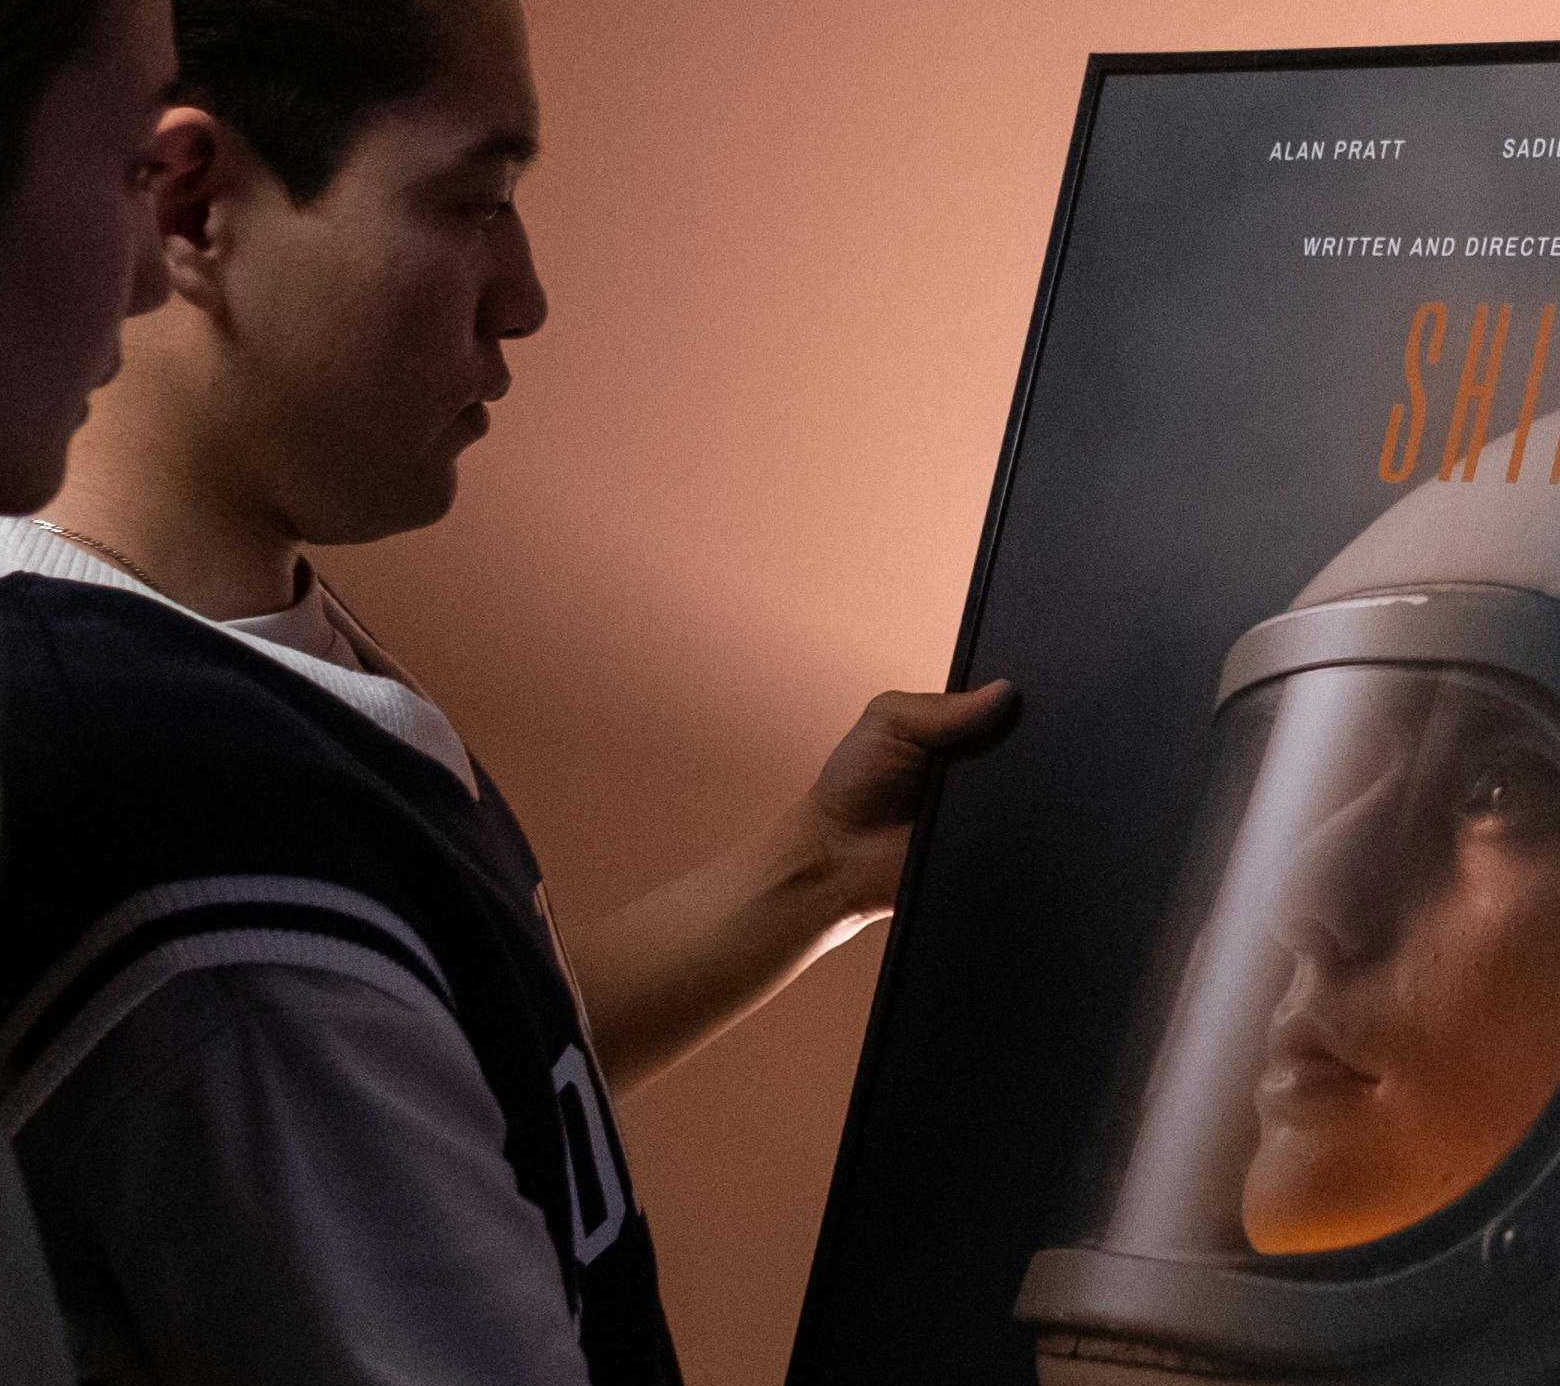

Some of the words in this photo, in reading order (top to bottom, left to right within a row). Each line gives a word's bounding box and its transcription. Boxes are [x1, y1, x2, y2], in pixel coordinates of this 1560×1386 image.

[1268, 140, 1325, 162] ALAN
[1333, 138, 1406, 160] PRATT
[1302, 237, 1402, 257] WRITTEN
[1409, 237, 1456, 257] AND
